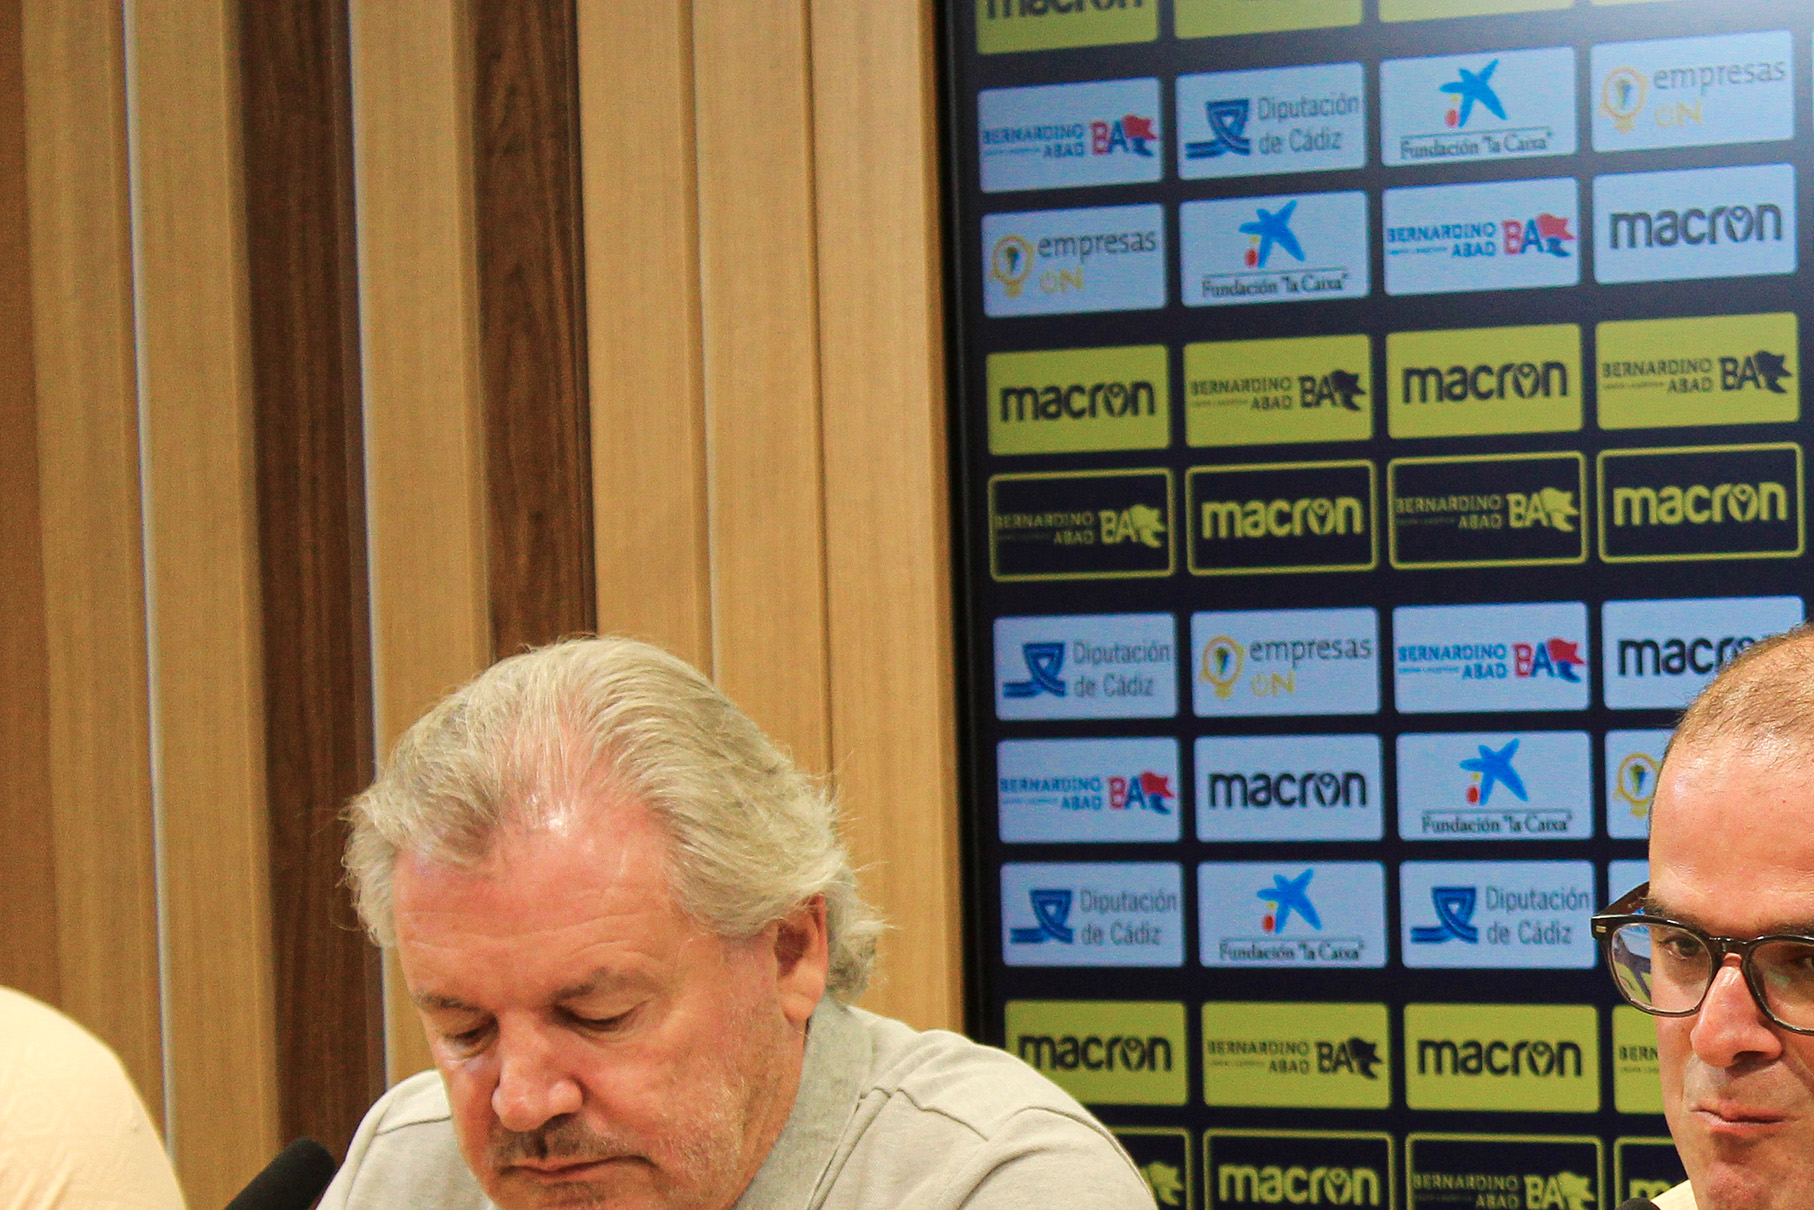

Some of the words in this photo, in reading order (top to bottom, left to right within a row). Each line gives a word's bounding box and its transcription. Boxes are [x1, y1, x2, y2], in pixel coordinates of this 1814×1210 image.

[1652, 56, 1788, 96] empresas
[1385, 221, 1496, 244] BERNARDINO
[1609, 203, 1783, 250] macron
[1402, 361, 1568, 404] macron
[1602, 357, 1713, 379] BERNARDINO
[999, 380, 1156, 423] macron
[1201, 496, 1364, 539] macron
[1395, 493, 1503, 514] BERNARDINO
[1613, 481, 1788, 526] macron
[1397, 643, 1507, 663] BERNARDINO
[1618, 637, 1757, 677] macr
[1209, 771, 1367, 808] macron
[1485, 885, 1590, 913] Diputación
[1486, 921, 1511, 945] de
[1517, 920, 1572, 945] Cádiz
[1017, 1034, 1173, 1072] macron
[1417, 1039, 1583, 1077] macron
[1218, 1164, 1380, 1206] macron
